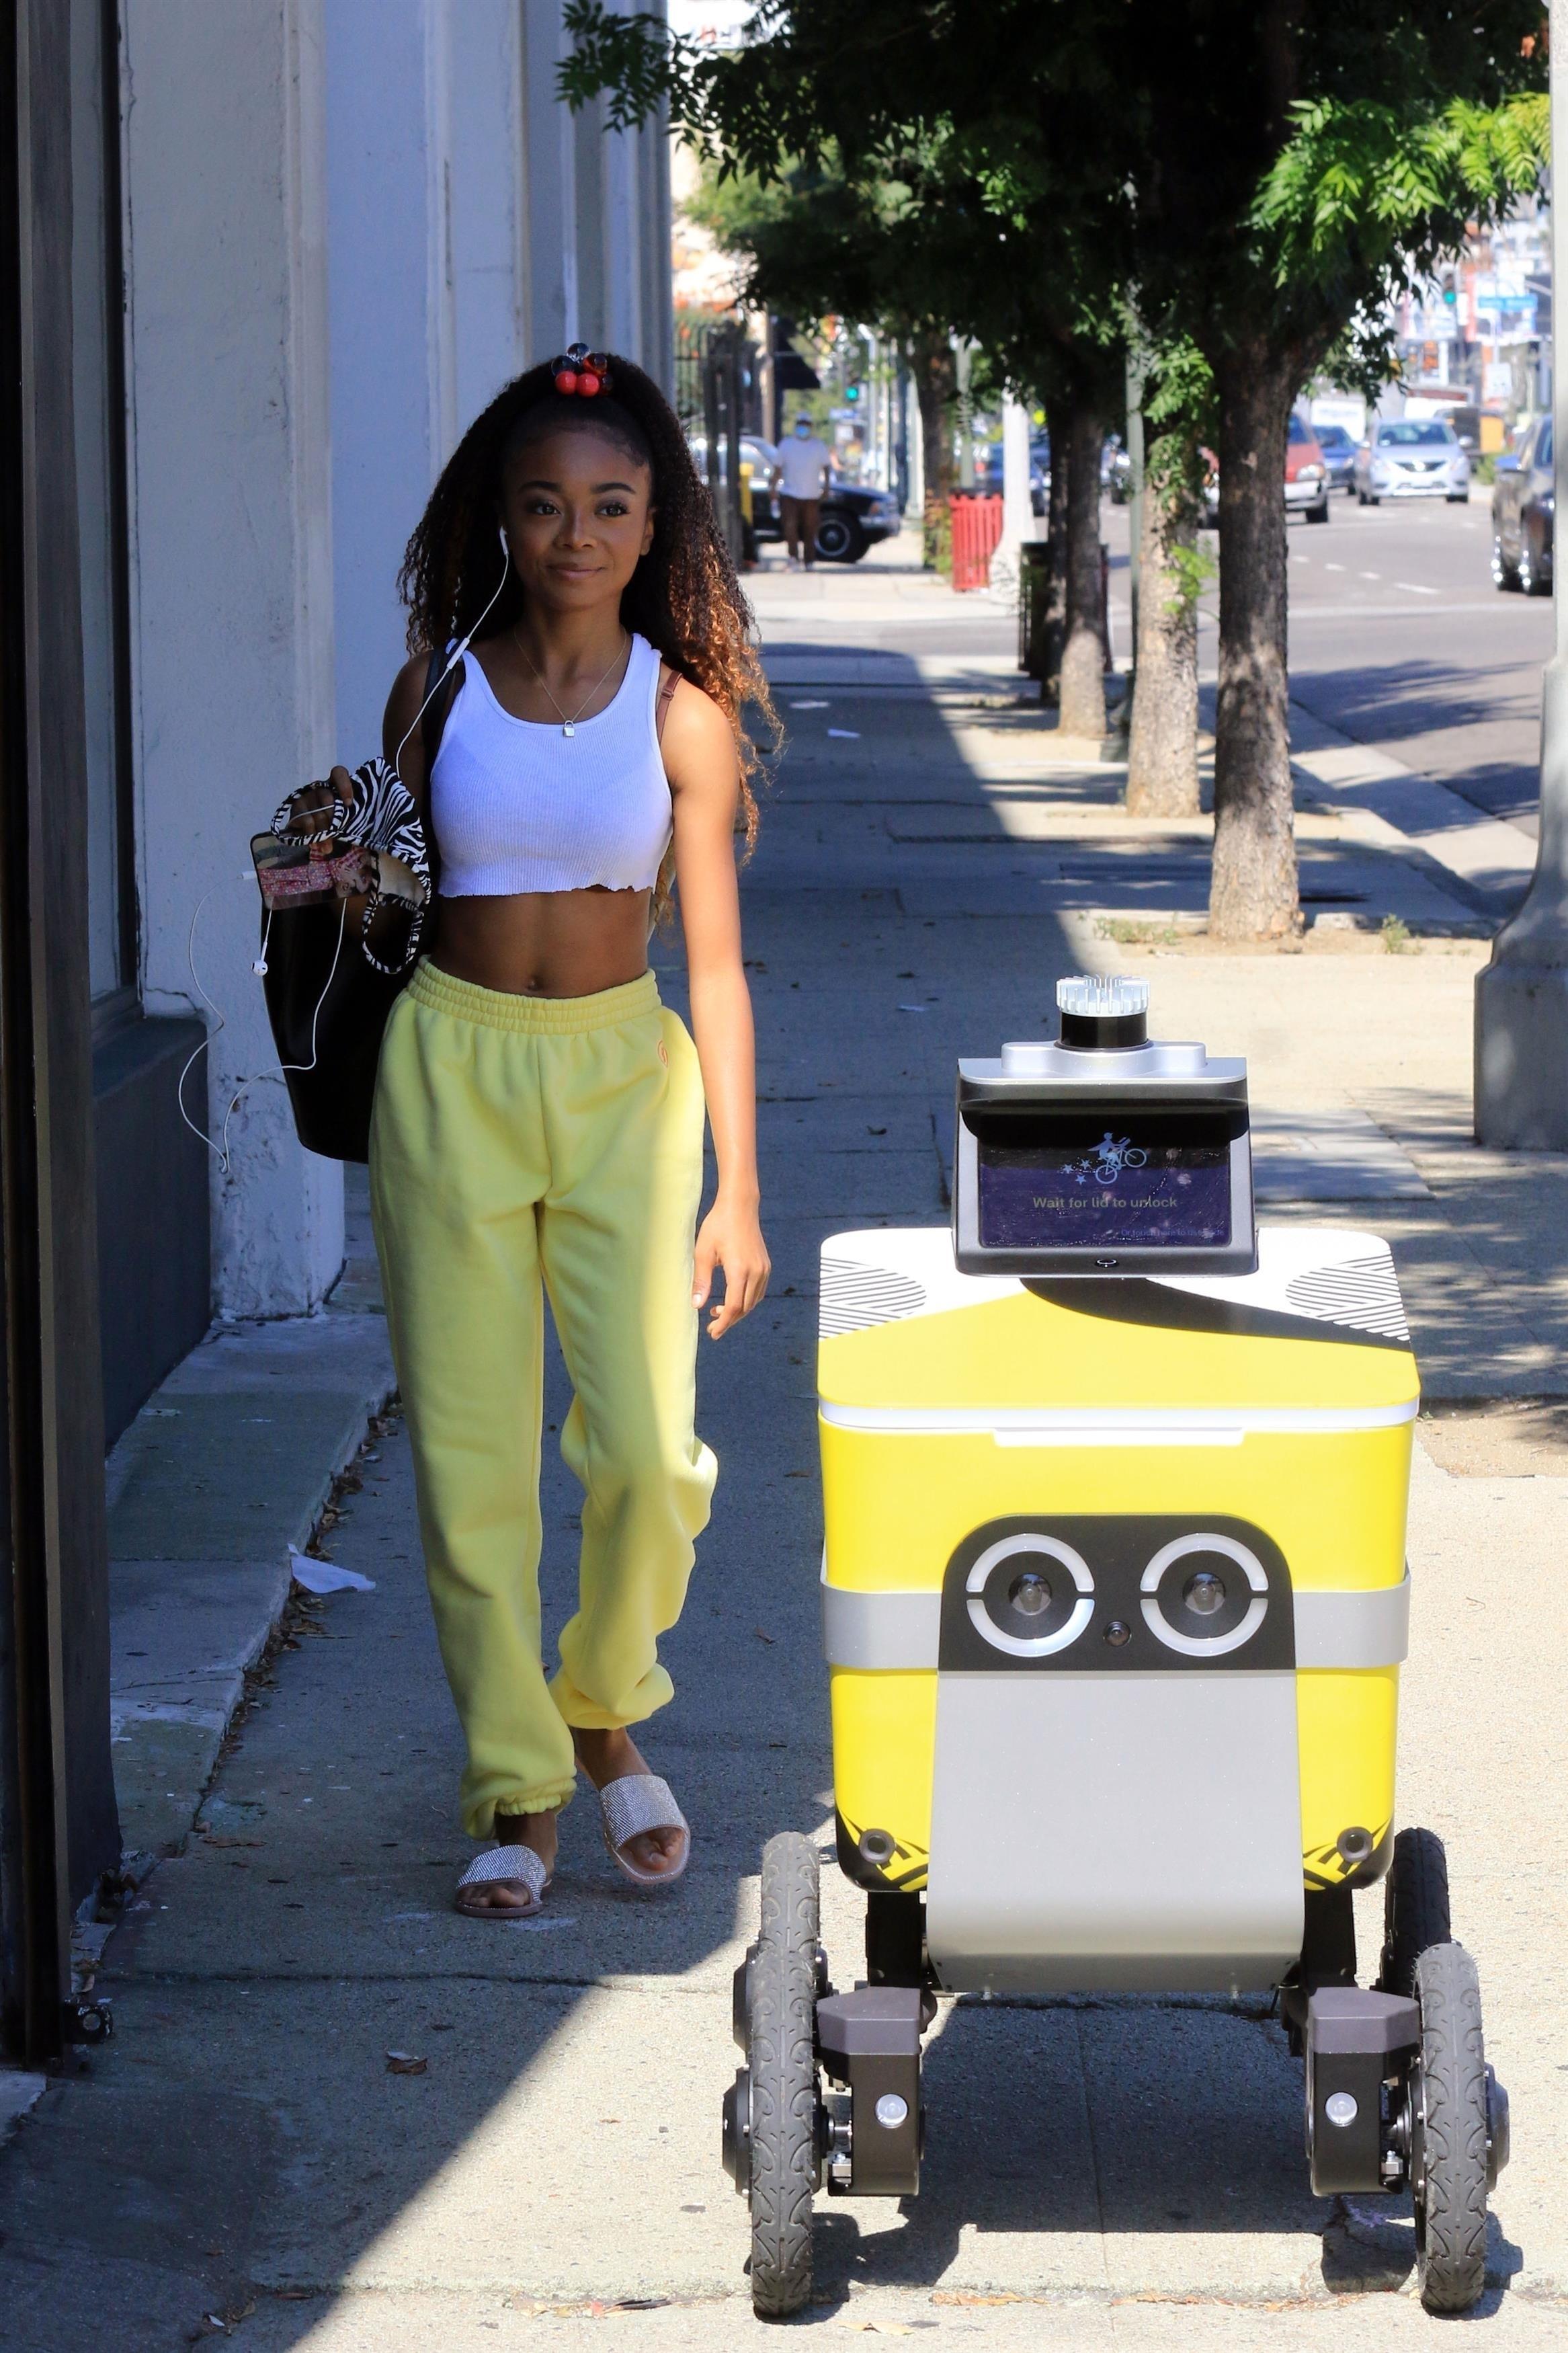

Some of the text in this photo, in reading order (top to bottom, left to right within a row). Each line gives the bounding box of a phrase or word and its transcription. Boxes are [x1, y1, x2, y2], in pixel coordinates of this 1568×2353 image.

[1032, 1197, 1178, 1208] Wait for lid to unlock
